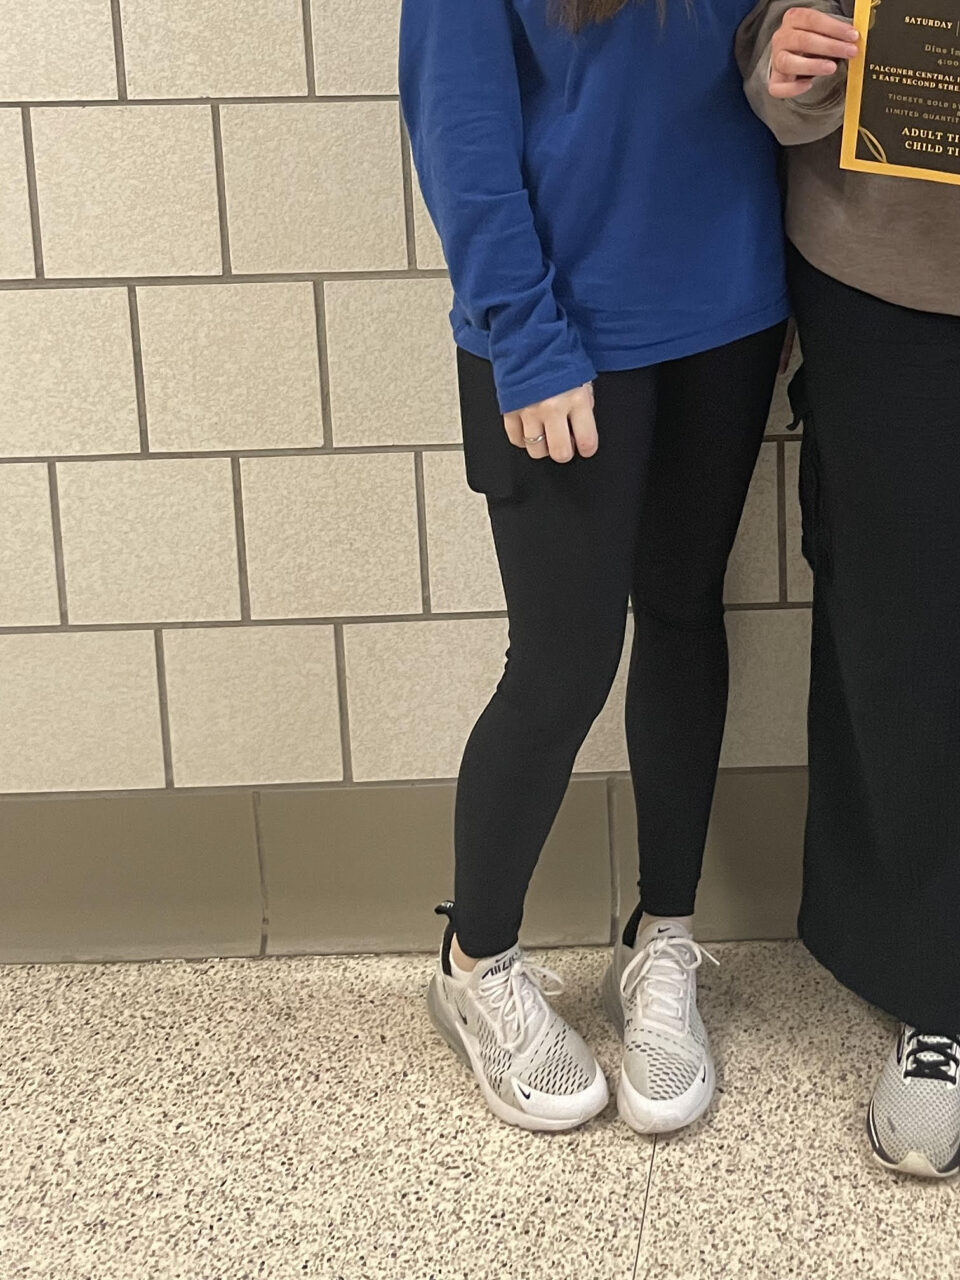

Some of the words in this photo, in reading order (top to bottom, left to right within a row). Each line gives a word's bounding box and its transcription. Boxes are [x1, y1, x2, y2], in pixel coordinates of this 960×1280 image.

[905, 16, 953, 30] SATURDAY
[925, 44, 947, 56] Dine
[951, 48, 960, 57] In
[870, 64, 914, 77] FALCONER
[916, 70, 955, 83] CENTRAL
[879, 75, 899, 84] EAST
[902, 78, 936, 89] SECOND
[888, 93, 923, 104] TICKETS
[927, 99, 949, 108] SOLD
[885, 107, 919, 118] LIMITED
[901, 127, 943, 141] ADULT
[905, 140, 943, 154] CHILD
